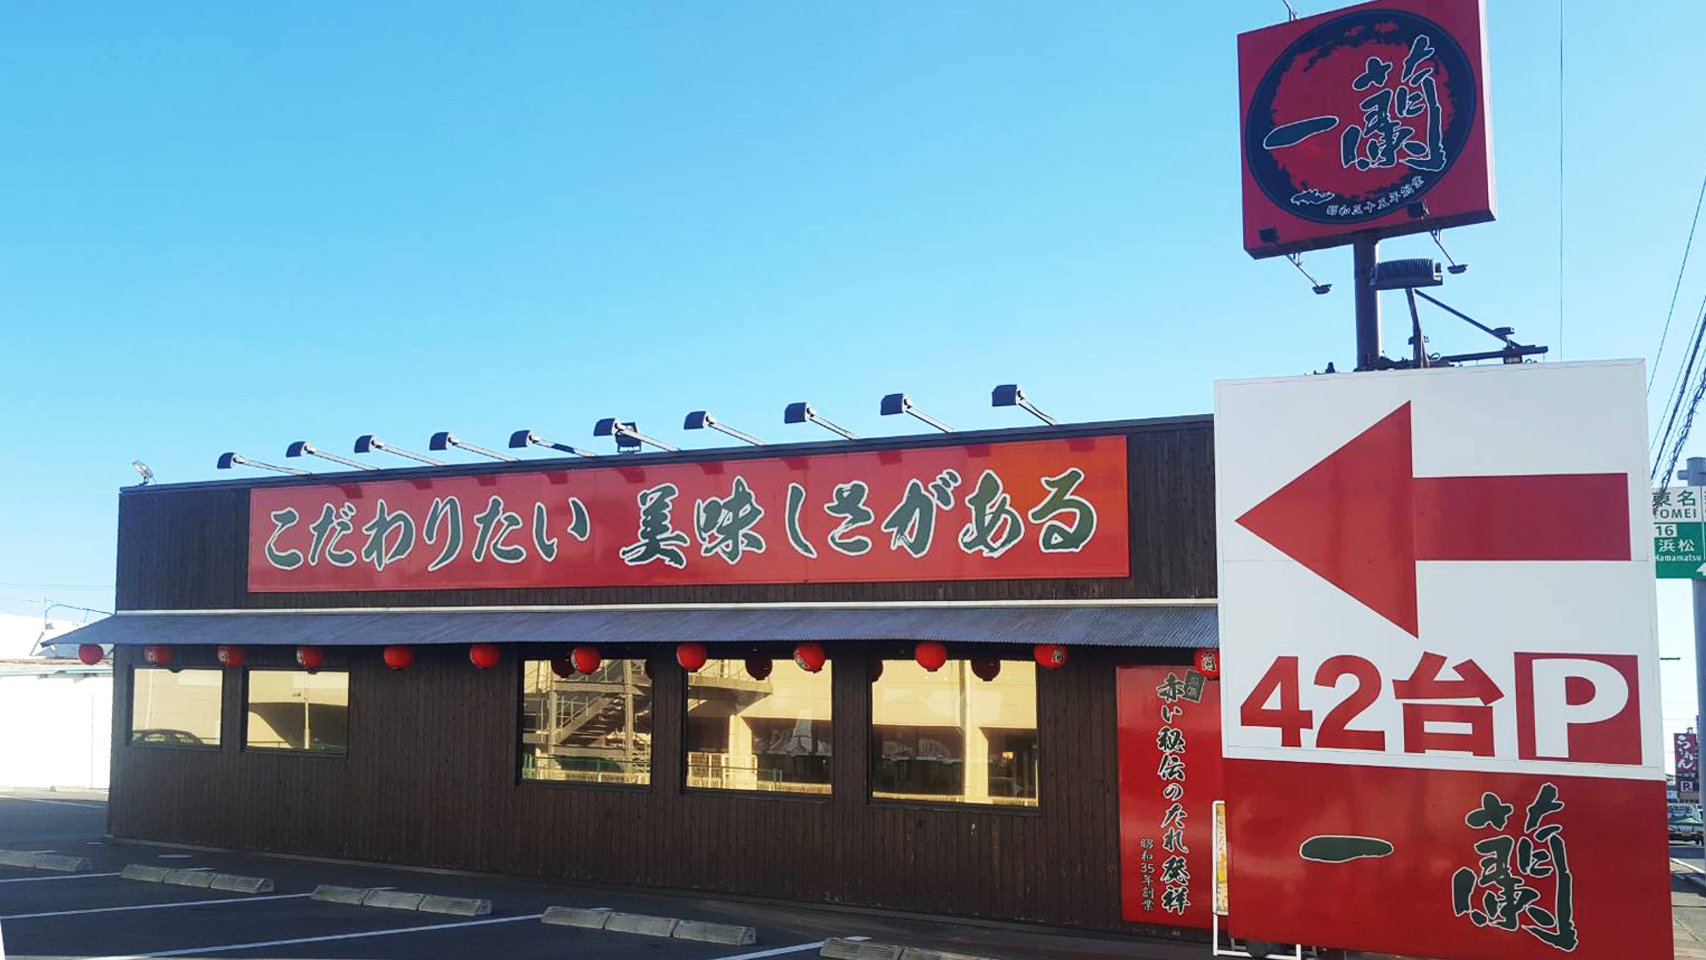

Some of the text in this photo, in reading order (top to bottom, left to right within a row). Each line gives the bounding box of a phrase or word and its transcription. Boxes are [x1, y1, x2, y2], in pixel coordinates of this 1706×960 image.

[1263, 35, 1447, 171] 一蘭
[265, 467, 1098, 572] こだわりたい 美味しさがある
[1652, 490, 1696, 507] 東名
[1656, 525, 1674, 537] 16
[1659, 539, 1695, 553] 浜松
[1299, 783, 1579, 952] 一蘭
